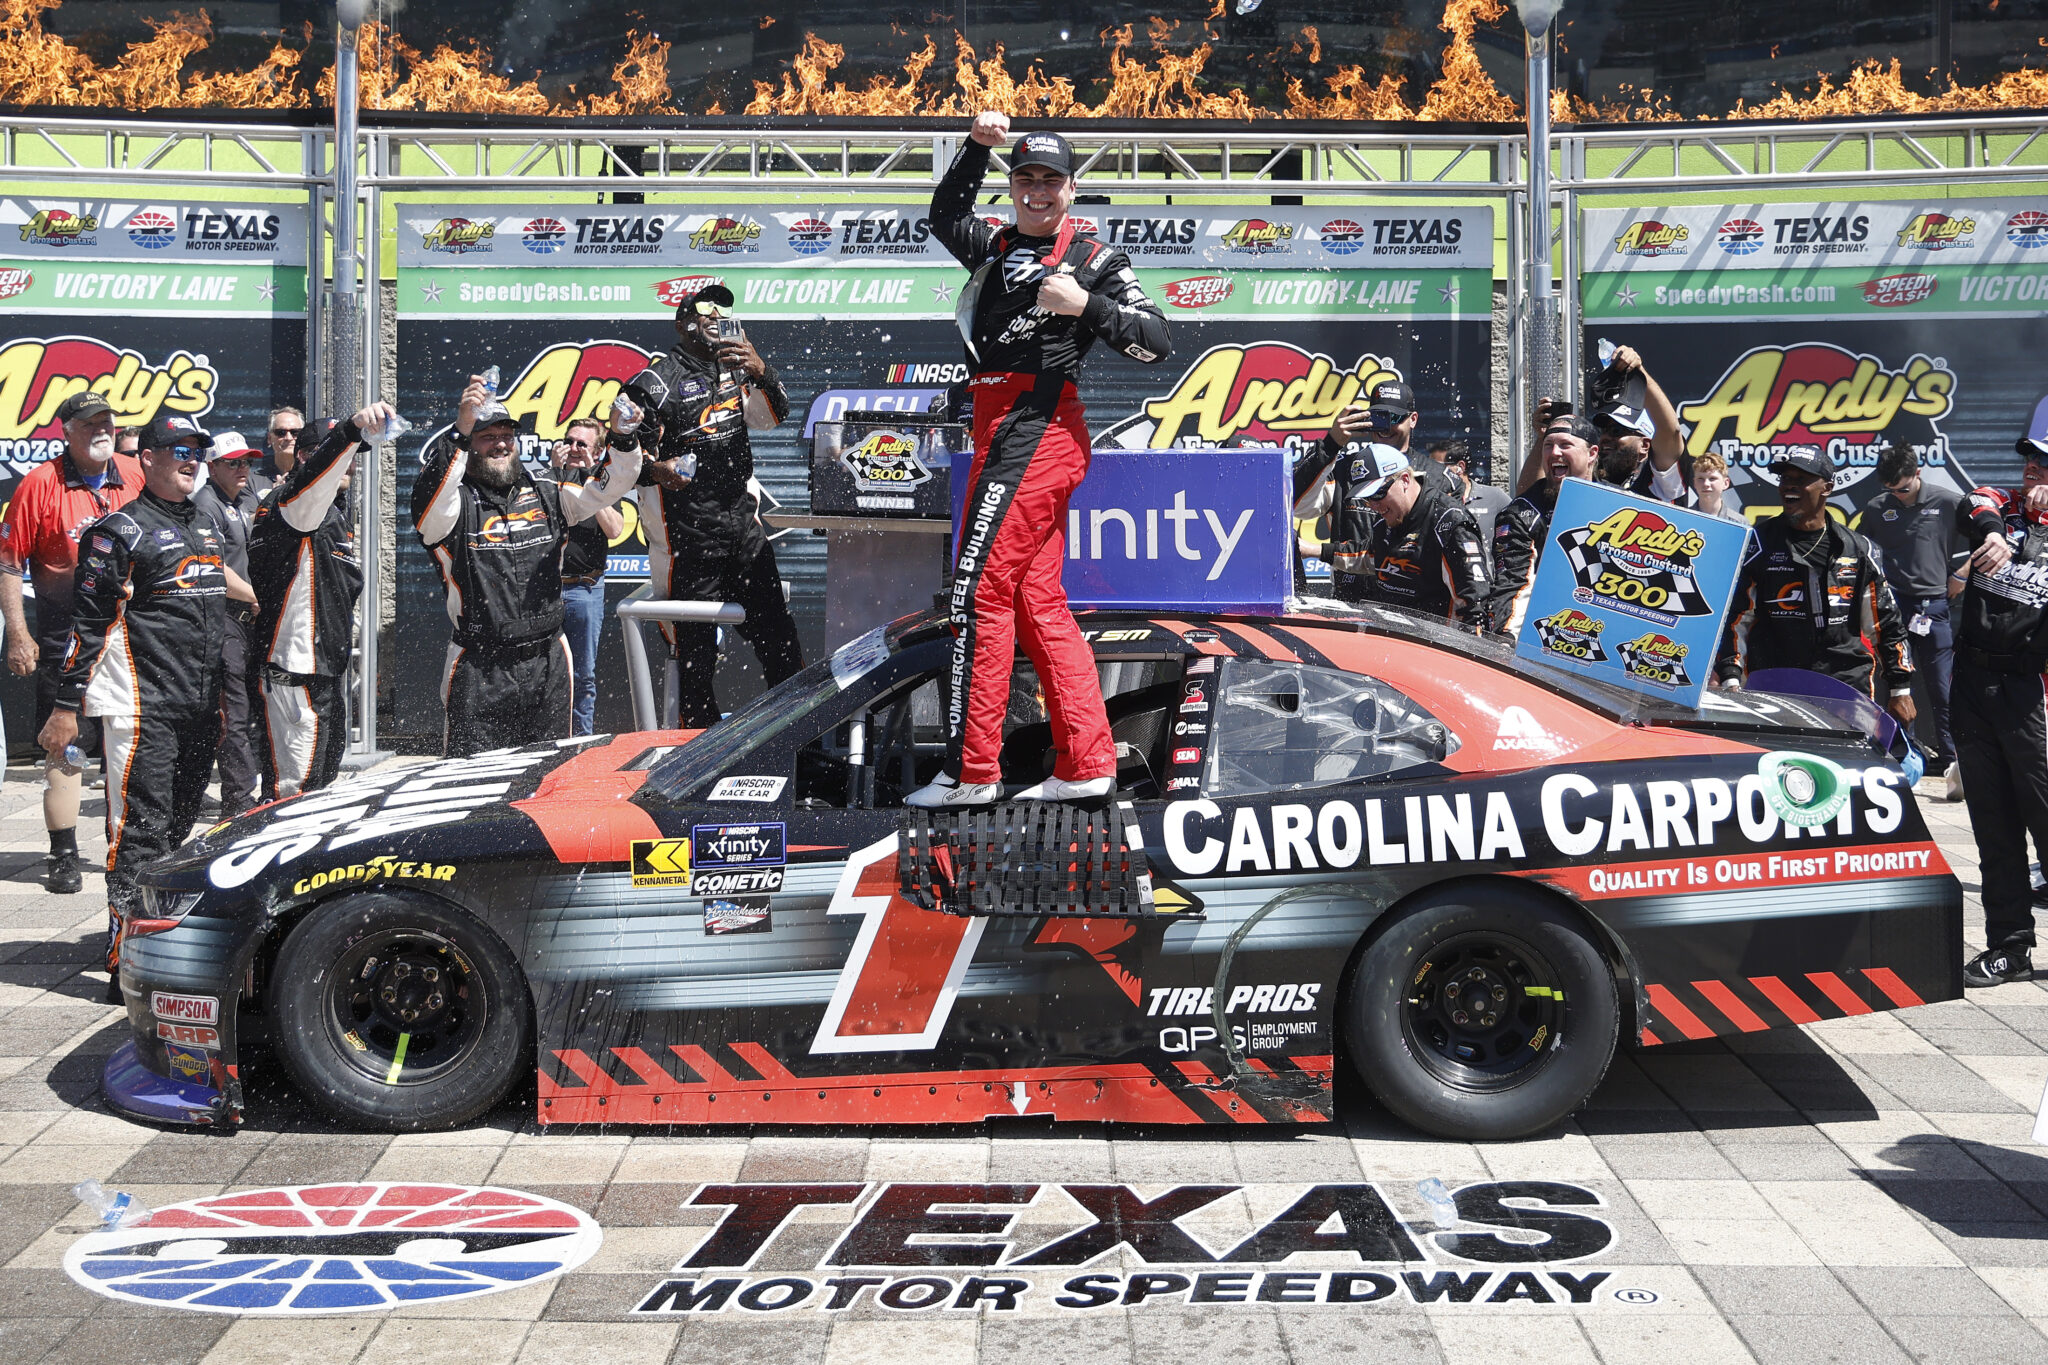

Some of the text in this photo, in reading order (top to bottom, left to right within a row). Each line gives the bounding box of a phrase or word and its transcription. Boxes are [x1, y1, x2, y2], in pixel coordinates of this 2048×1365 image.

[18, 209, 98, 242] Andy's
[185, 214, 280, 240] TEXAS
[423, 219, 495, 249] Andy's
[575, 218, 664, 243] TEXAS
[689, 218, 761, 249] Andy's
[841, 218, 929, 244] TEXAS
[1107, 219, 1197, 244] TEXAS
[1221, 219, 1294, 250] Andy's
[1372, 218, 1463, 244] TEXAS
[1615, 221, 1689, 254] Andy's
[1774, 216, 1870, 244] TEXAS
[1898, 214, 1976, 247] Andy's
[185, 241, 277, 252] MOTOR SPEEDWAY
[574, 245, 660, 254] MOTOR SPEEDWAY
[840, 245, 926, 254] MOTOR SPEEDWAY
[1112, 245, 1193, 255] OTOR SPEEDWAY
[1373, 245, 1460, 255] MOTOR SPEEDWAY
[1774, 243, 1866, 255] MOTOR SPEEDWAY
[54, 273, 238, 301] VICTORY LANE
[459, 282, 631, 302] SpeedyCash.com
[744, 279, 914, 304] VICTORY LANE
[1178, 277, 1232, 295] SPEEDY
[1252, 280, 1421, 305] VICTORY LANE
[1655, 284, 1836, 306] SpeedyCash.com
[1876, 273, 1936, 294] SPEEDY
[1683, 350, 1950, 457] Andy's
[859, 435, 915, 459] Andy's
[869, 469, 905, 480] 300
[856, 496, 915, 509] WINNER
[959, 482, 1006, 571] BUILDINGS
[1069, 489, 1254, 581] inity
[1586, 509, 1705, 558] Andy's
[1600, 540, 1695, 579] Frozen Custard
[951, 575, 970, 624] STEEL
[1595, 572, 1668, 608] 300
[1547, 608, 1605, 633] Andy's
[1595, 595, 1676, 624] TEXAS MOTOR SPEEDWAY
[1551, 640, 1587, 658] 300
[1630, 633, 1689, 657] Andy's
[1634, 664, 1671, 682] 300
[1176, 750, 1196, 761] SEM
[719, 789, 770, 798] RACE CAR
[735, 778, 776, 788] NASCAR
[1787, 794, 1847, 825] BIOETHANOL
[728, 826, 760, 835] NASCAR
[1163, 789, 1526, 875] CAROLINA
[708, 836, 771, 858] xfinity
[727, 854, 752, 863] SERIES
[634, 876, 688, 886] KENNAMETAL
[694, 872, 783, 892] COMETIC
[705, 903, 769, 919] Arrowhead
[156, 997, 212, 1019] SIMPSON
[1147, 983, 1321, 1016] TIRE PROS
[158, 1023, 218, 1044] ARP
[1160, 1022, 1317, 1052] QPS EMPLOYMENT
[1252, 1037, 1285, 1049] GROUP
[172, 1058, 207, 1071] SUNOCO
[673, 1180, 1619, 1271] TEXAS
[629, 1270, 1621, 1314] MOTOR SPEEDWAY
